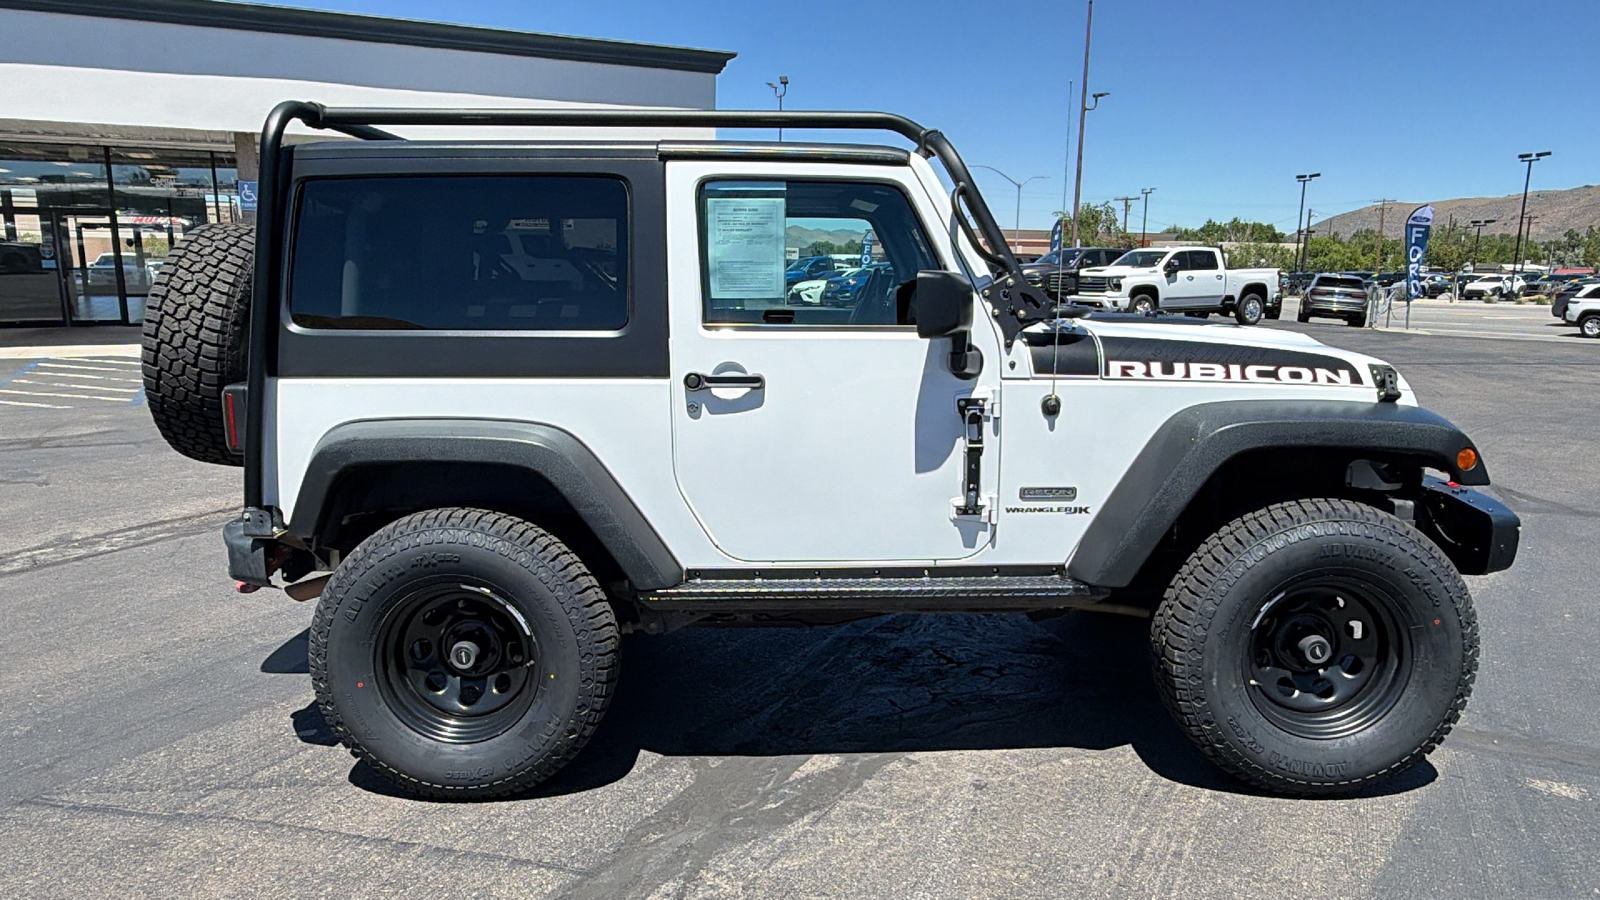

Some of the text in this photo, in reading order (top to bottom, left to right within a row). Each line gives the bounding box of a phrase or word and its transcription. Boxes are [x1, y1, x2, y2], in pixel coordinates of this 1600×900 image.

[1409, 227, 1426, 295] FORD
[1108, 360, 1351, 384] RUBICON
[1320, 543, 1396, 571] ADVANTA
